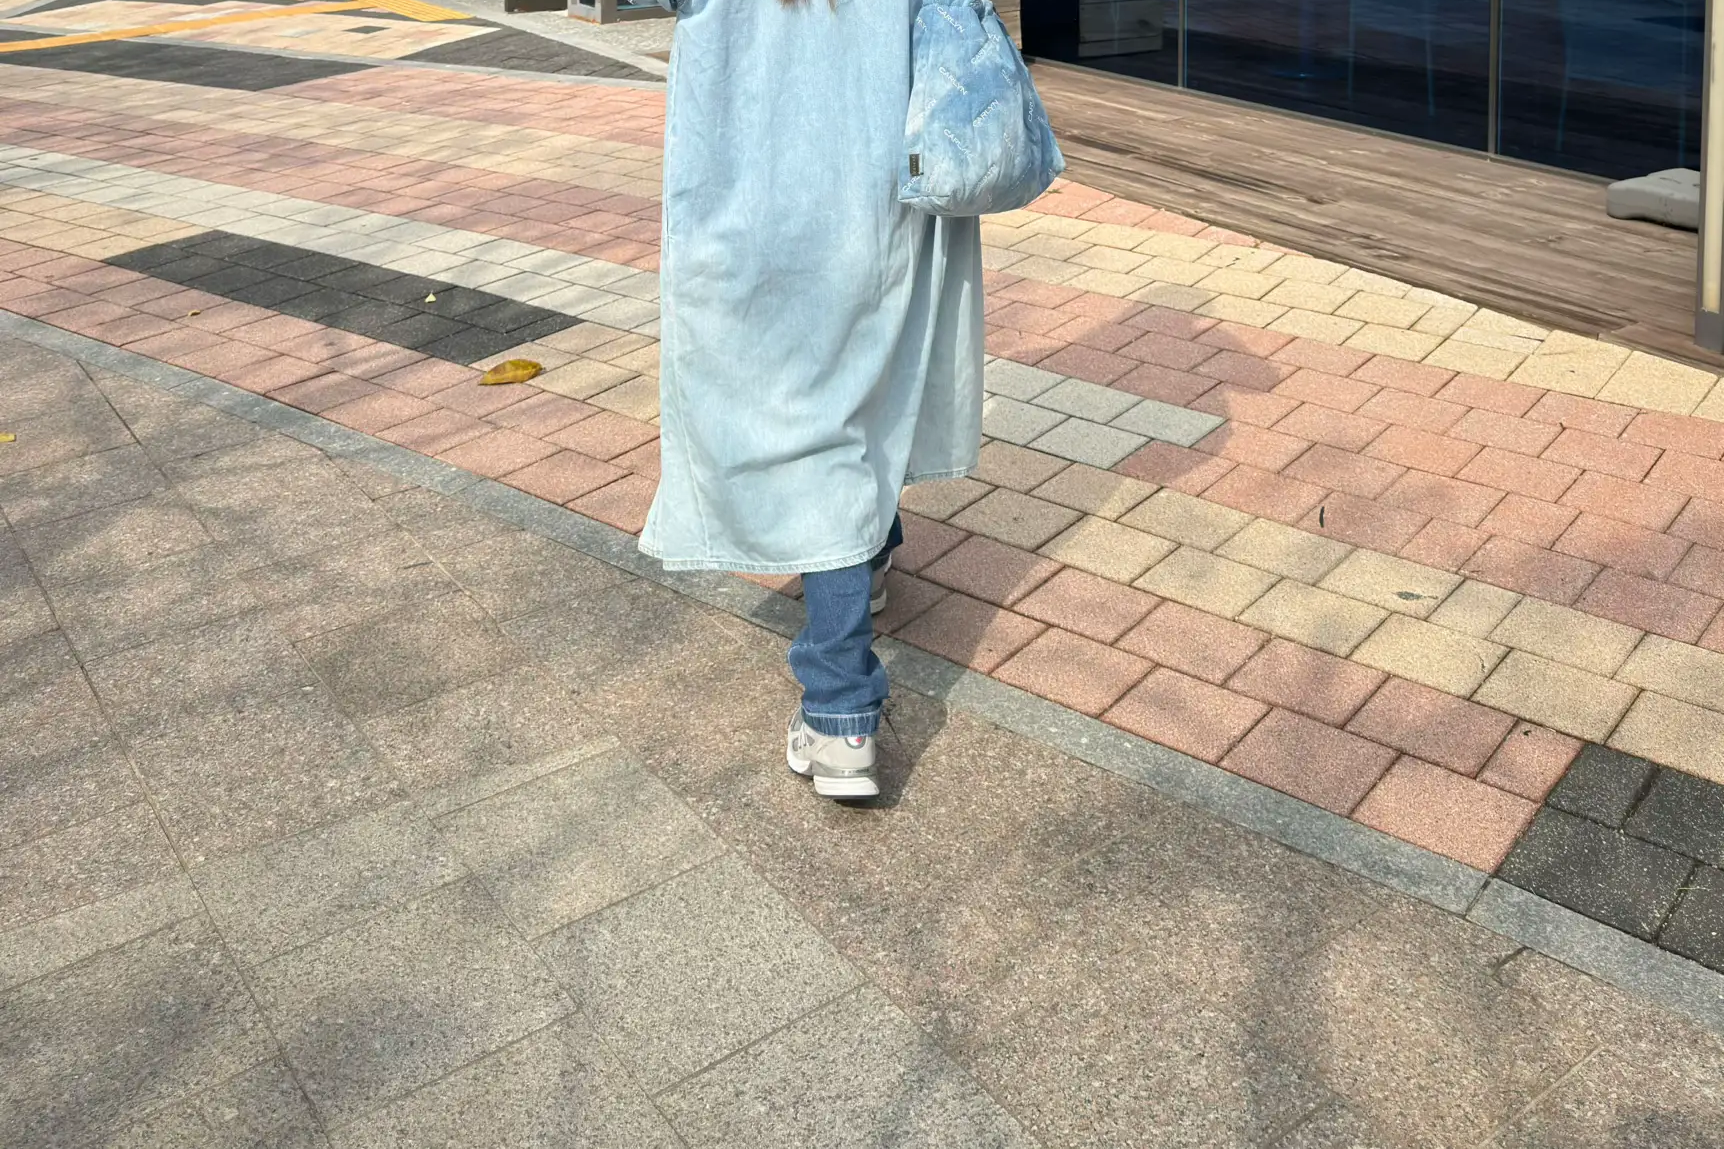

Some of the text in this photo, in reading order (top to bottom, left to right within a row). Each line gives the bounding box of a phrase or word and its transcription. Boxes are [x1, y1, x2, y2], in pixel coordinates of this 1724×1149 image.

[936, 6, 966, 33] CARLYN
[938, 66, 967, 96] CARLYN
[972, 98, 999, 127] CARLYN
